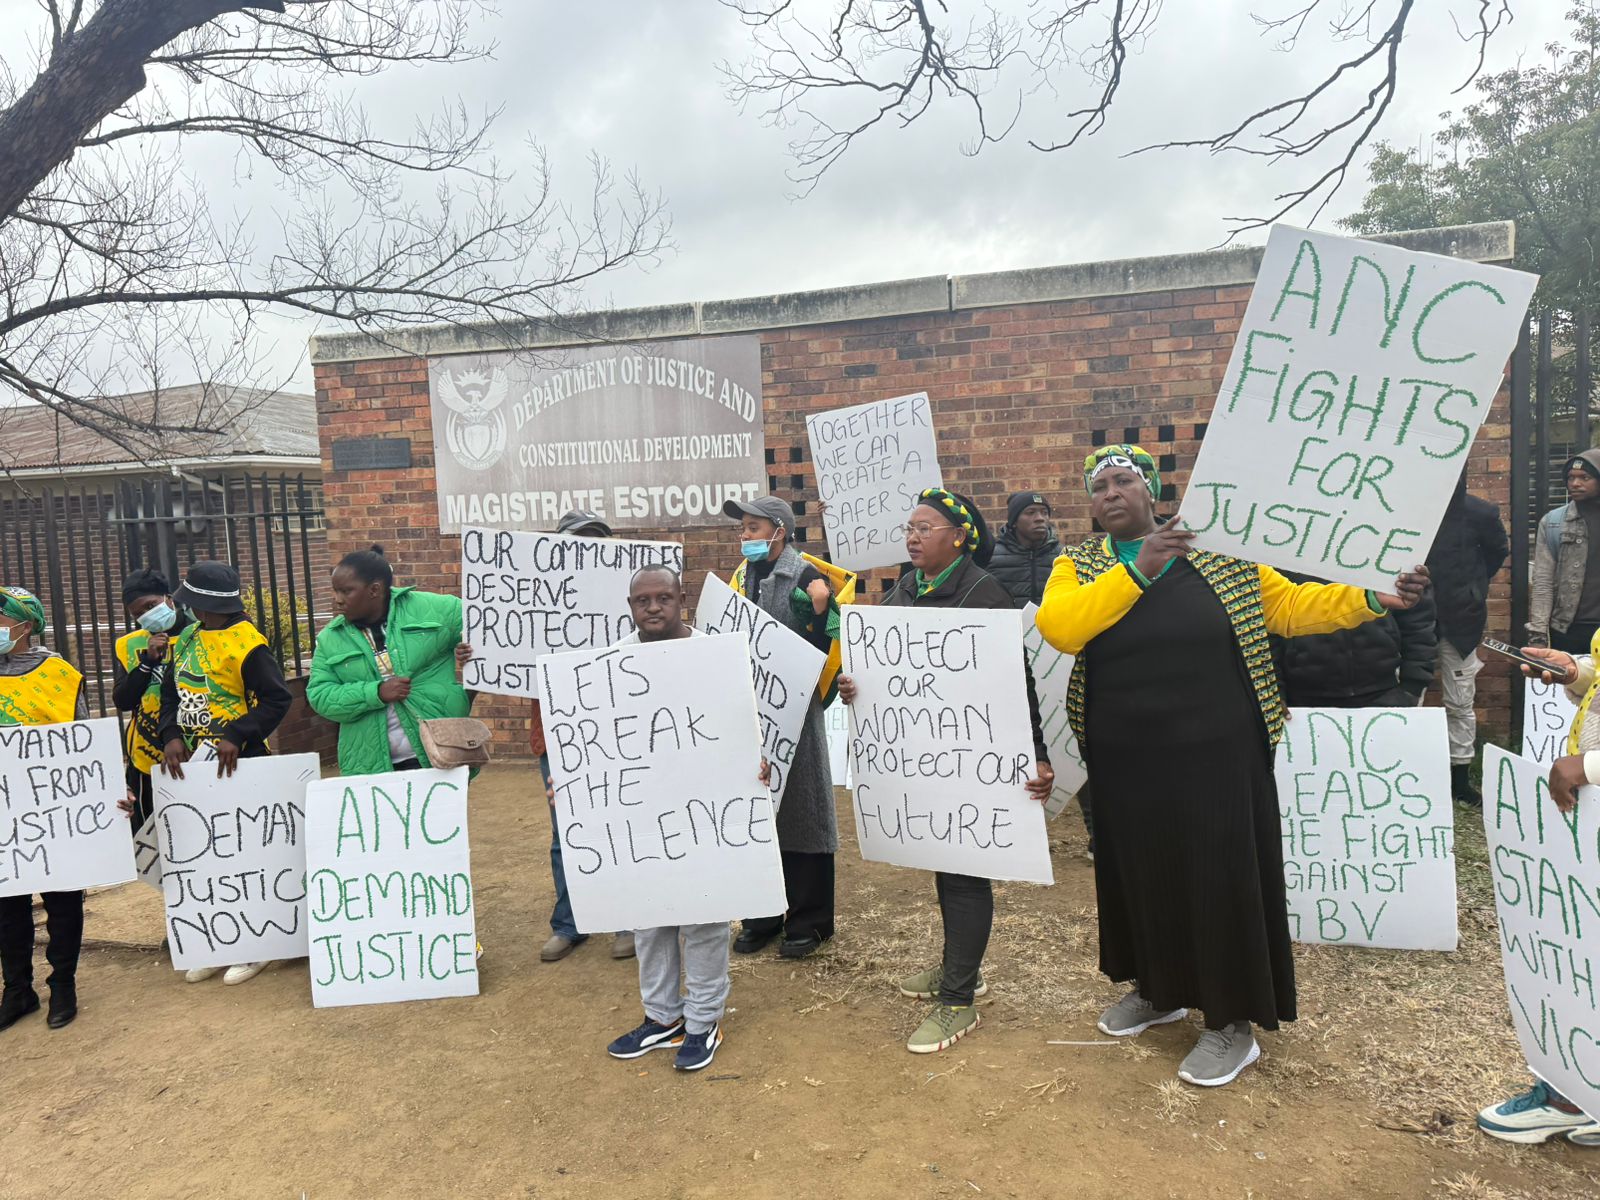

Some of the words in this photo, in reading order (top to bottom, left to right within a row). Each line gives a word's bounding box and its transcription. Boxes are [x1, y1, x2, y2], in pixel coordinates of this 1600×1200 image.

[1270, 240, 1505, 364] ANC
[512, 357, 617, 432] DEPARTMENT
[620, 355, 643, 385] OF
[647, 356, 715, 400] JUSTICE
[719, 377, 756, 423] AND
[808, 397, 929, 450] TOGETHER
[520, 438, 641, 468] CONSTITUTIONAL
[644, 432, 752, 461] DEVELOPMENT
[816, 446, 848, 471] WE
[855, 431, 901, 464] CAN
[821, 455, 893, 501] CREATE
[902, 450, 923, 474] A
[1288, 437, 1394, 513] FOR
[445, 488, 606, 523] MAGISTRATE
[614, 482, 759, 518] ESTCOURT
[823, 491, 892, 530] SAFER
[464, 530, 518, 571] OUR
[466, 573, 577, 610] DESERVE
[720, 593, 778, 660] ANC
[544, 650, 650, 717] LETS
[551, 706, 719, 773] BREAK
[852, 703, 994, 745] WOMAN
[1532, 701, 1565, 731] IS
[27, 760, 105, 806] FROM
[556, 766, 651, 817] THE
[1280, 770, 1431, 818] EADS
[337, 781, 460, 857] ANC
[566, 797, 772, 874] SILENCE
[311, 868, 470, 922] DEMAND
[171, 905, 298, 955] NOW
[313, 931, 475, 986] JUSTICE
